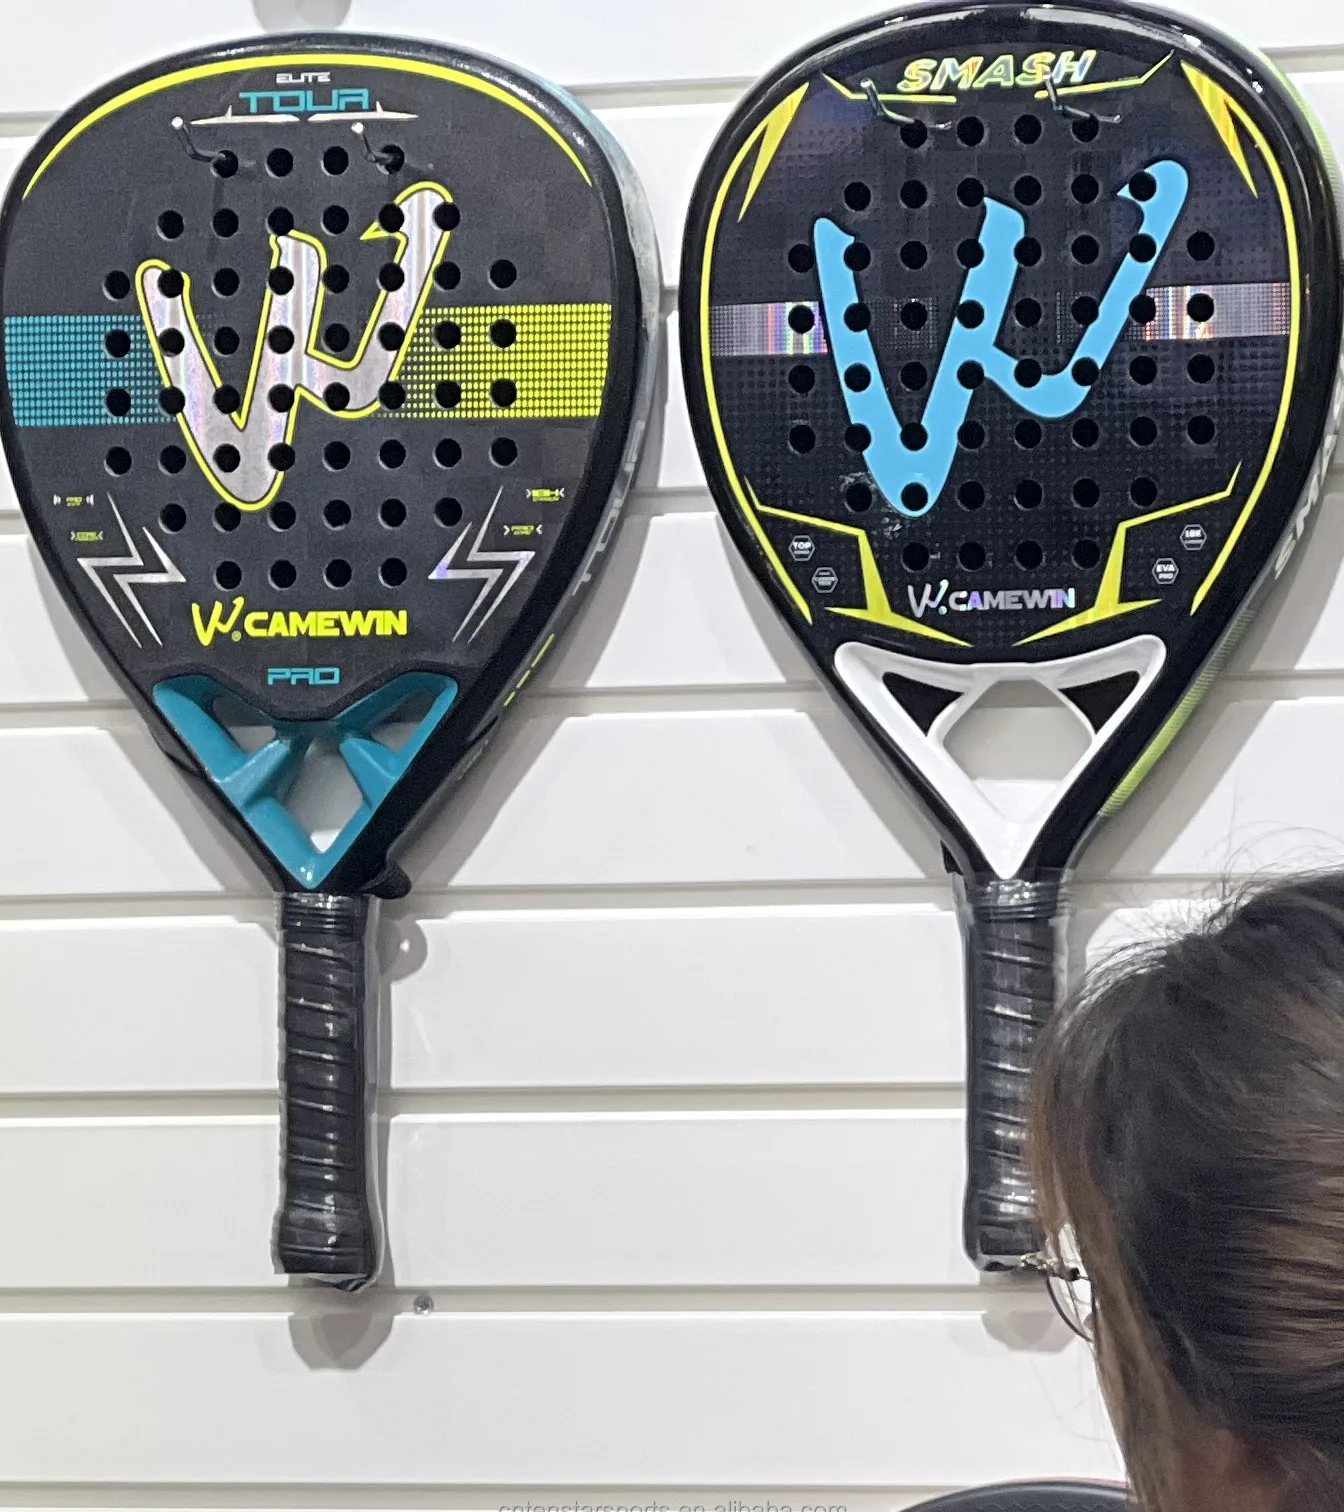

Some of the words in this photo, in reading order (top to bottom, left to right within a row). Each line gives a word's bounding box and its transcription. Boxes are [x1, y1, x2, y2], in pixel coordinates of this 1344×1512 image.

[896, 50, 1097, 92] SMASH
[239, 88, 369, 113] TOUR
[792, 541, 811, 550] TOP
[1156, 564, 1175, 572] EVA
[948, 587, 1075, 612] CAMEWIN
[244, 609, 408, 637] CAMEWIN
[267, 667, 340, 685] PRO
